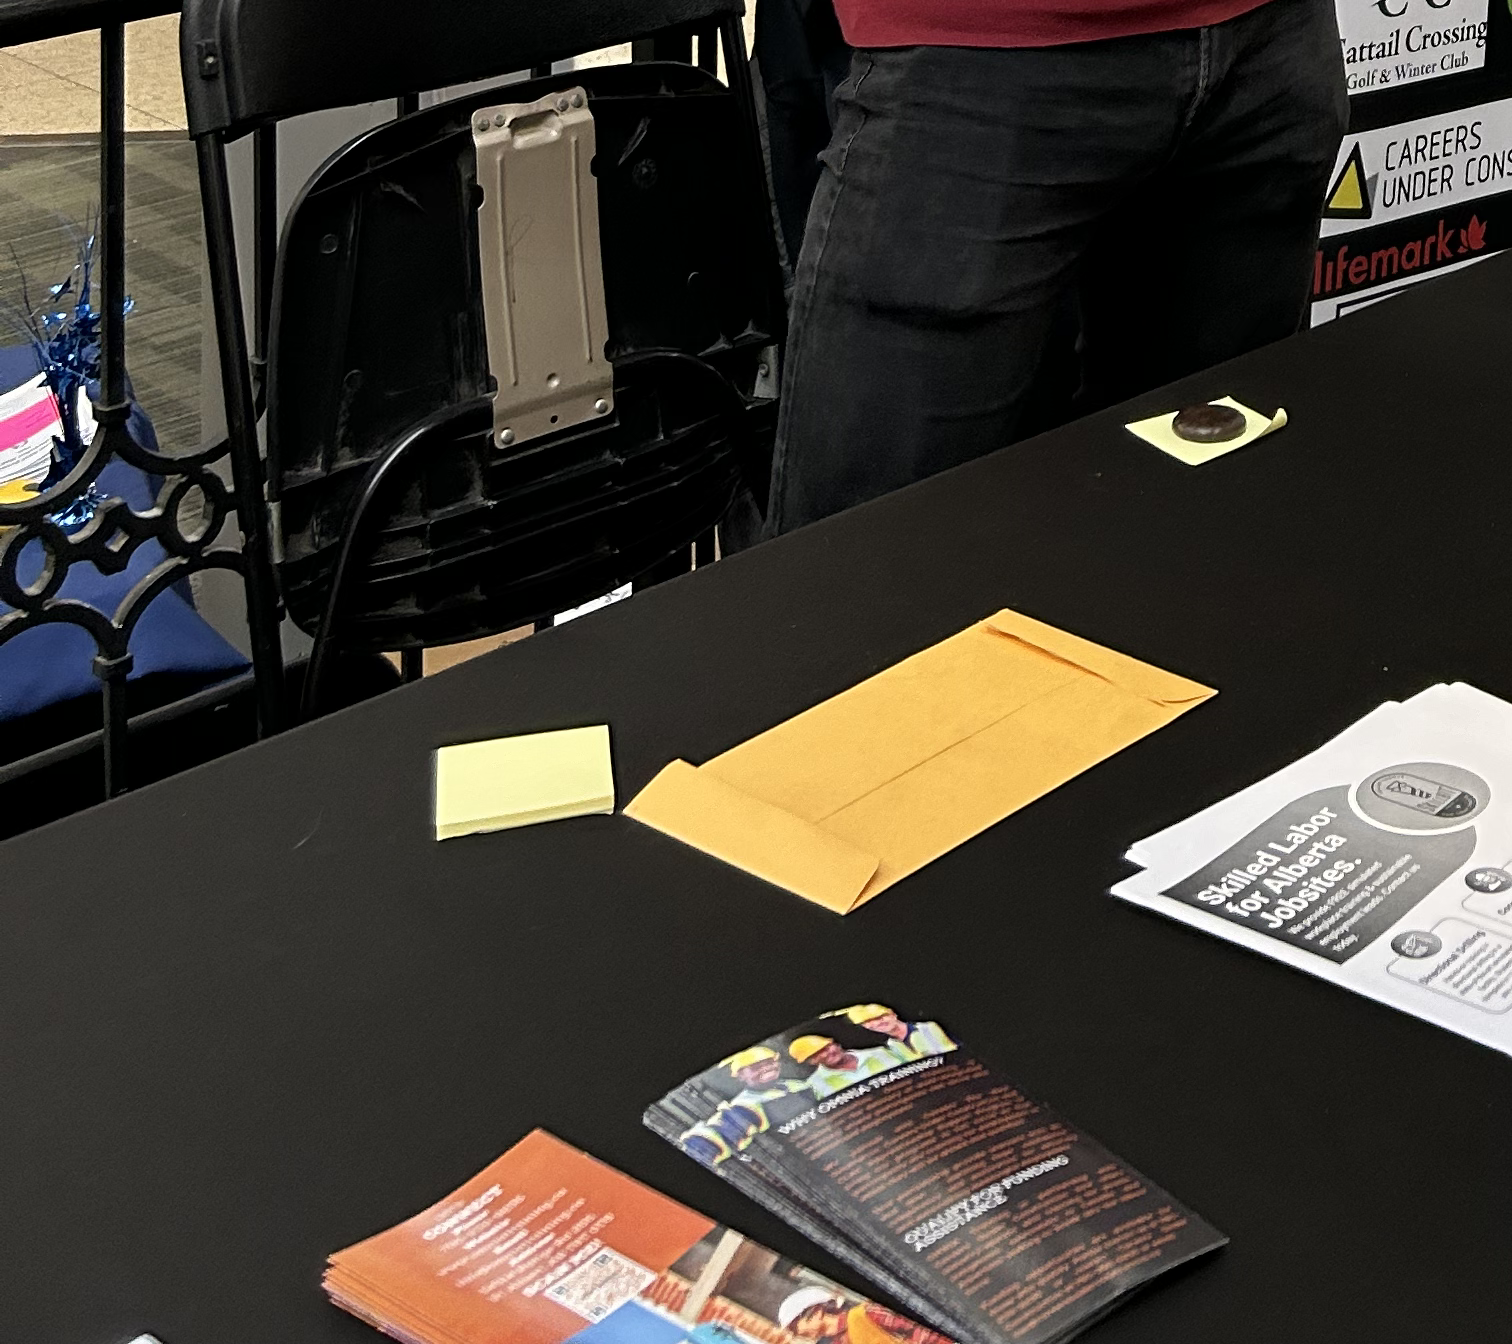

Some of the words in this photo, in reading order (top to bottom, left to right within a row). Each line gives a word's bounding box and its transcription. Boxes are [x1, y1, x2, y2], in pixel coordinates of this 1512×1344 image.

[1340, 28, 1401, 65] attail
[1405, 17, 1489, 53] Crossing
[1346, 68, 1379, 90] Golf
[1379, 68, 1392, 84] &
[1394, 61, 1438, 81] Winter
[1440, 50, 1469, 72] Club
[1385, 121, 1483, 171] CAREERS
[1382, 163, 1453, 208] UNDER
[1313, 226, 1454, 296] lifemark
[1198, 851, 1281, 905] Skilled
[1268, 806, 1337, 854] Labor
[1225, 890, 1269, 917] for
[1262, 834, 1347, 895] Alberta
[1260, 858, 1362, 929] Jobsites.
[1001, 1153, 1070, 1190] FUNDING
